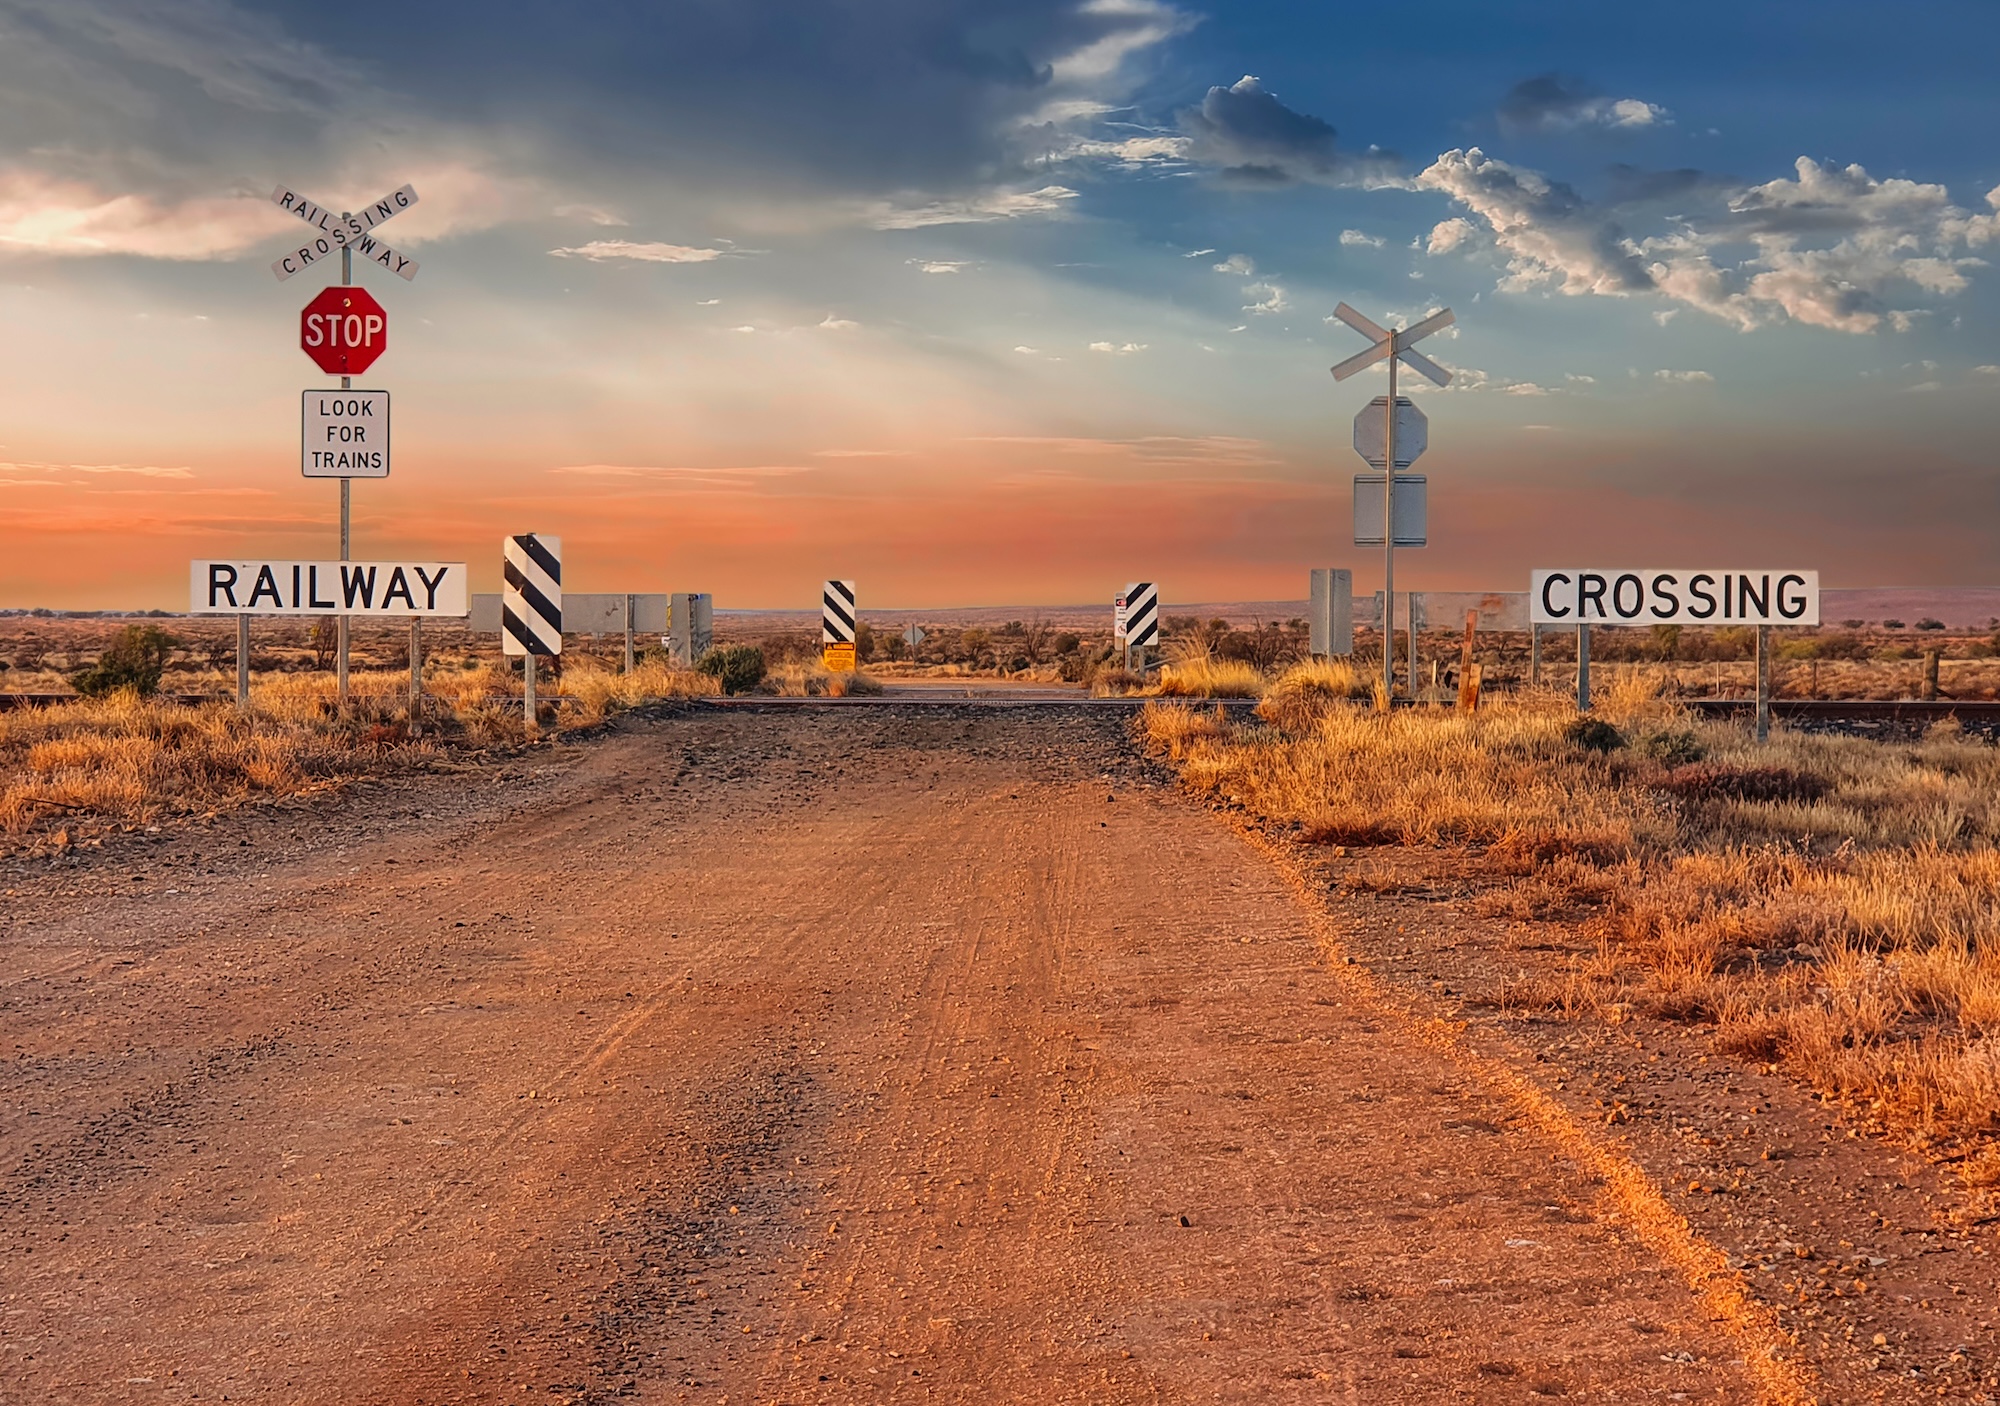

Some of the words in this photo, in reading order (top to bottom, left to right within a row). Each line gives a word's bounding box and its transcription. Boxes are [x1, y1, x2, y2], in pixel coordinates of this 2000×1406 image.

[282, 191, 408, 273] CROSSING
[305, 313, 383, 347] STOP
[320, 400, 373, 416] LOOK
[327, 426, 365, 442] FOR
[312, 452, 381, 468] TRAINS
[209, 564, 448, 610] RAILWAY
[1542, 573, 1807, 619] CROSSING
